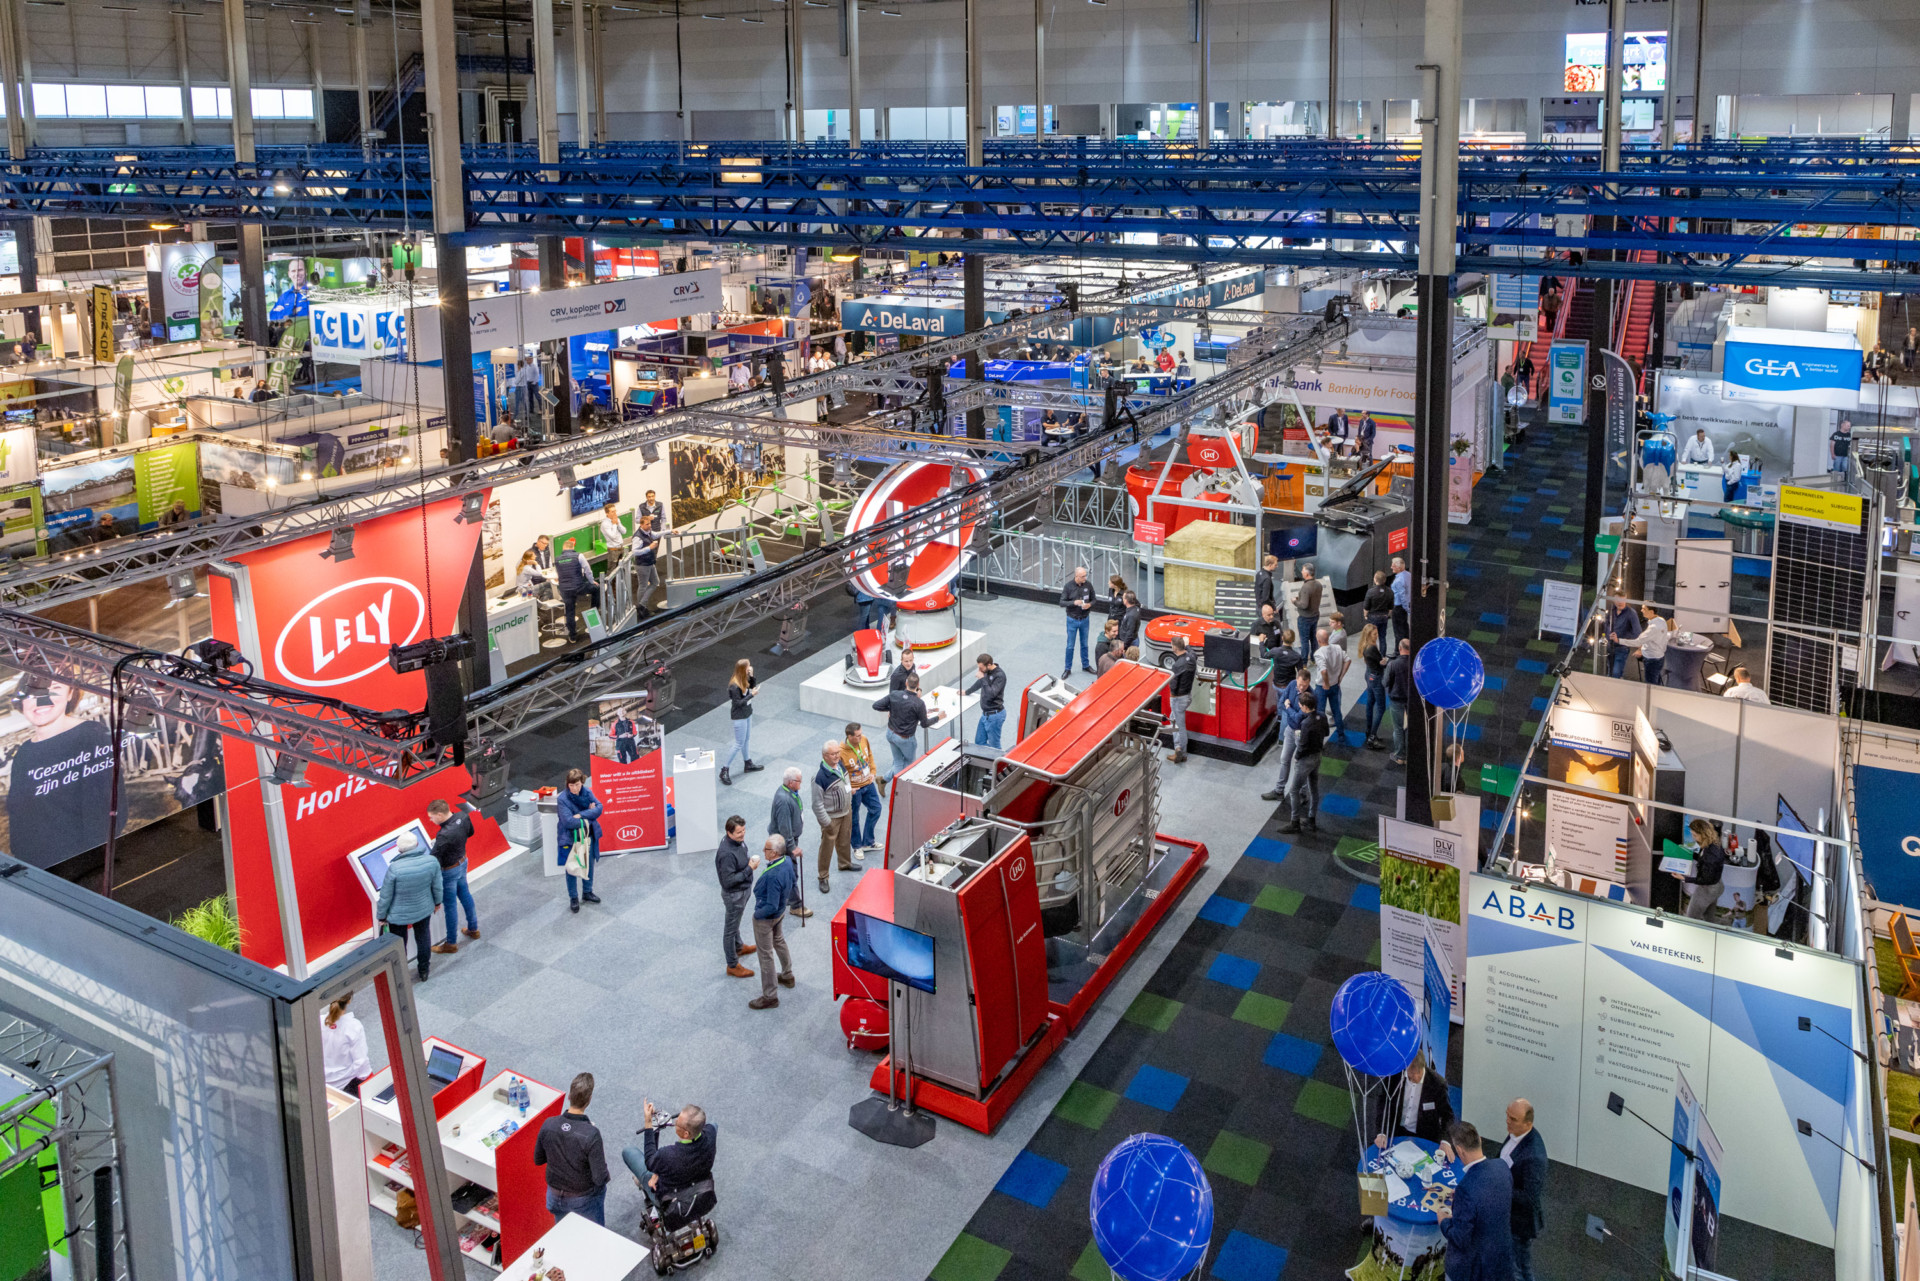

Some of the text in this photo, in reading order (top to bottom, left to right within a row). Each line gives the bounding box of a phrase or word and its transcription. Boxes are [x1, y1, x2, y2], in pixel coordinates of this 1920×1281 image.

[1580, 47, 1606, 57] Foo
[673, 284, 691, 296] CRV
[1231, 278, 1256, 300] DeLaval
[569, 303, 601, 316] koploper
[100, 292, 108, 359] TORNADO
[321, 310, 365, 343] GD
[880, 310, 944, 333] DeLaval
[1745, 358, 1800, 378] GEA
[1265, 375, 1323, 392] abbank
[1328, 382, 1370, 398] Banking
[1373, 386, 1388, 397] for
[1699, 384, 1721, 395] GE
[1700, 416, 1743, 425] melkkwaliteit
[1785, 489, 1824, 500] ZONNEPANELEN
[1783, 503, 1825, 514] ENERGIE-OPSLAG
[1830, 503, 1857, 512] SUBSIDIES
[309, 588, 393, 674] LELY
[1614, 723, 1631, 733] DLV
[1555, 732, 1603, 745] BEDRIJFSOVERNAME
[28, 735, 136, 781] "Gezonde koen
[35, 757, 115, 796] zijn de basis
[296, 760, 398, 821] Horizn
[1436, 840, 1452, 851] DLV
[1901, 835, 1920, 857] Q
[1482, 890, 1575, 930] ABAB
[1630, 939, 1704, 964] VAN BETEKENIS.
[1499, 970, 1541, 984] ACCOUNTANCY
[1499, 981, 1515, 989] AUDIT
[1525, 987, 1558, 1000] ASSURANCE
[1498, 992, 1548, 1009] BELASTINGADVIES
[1498, 1003, 1520, 1013] SALARIS
[1610, 999, 1661, 1016] INTERNATIONAAL
[1498, 1008, 1559, 1029] PERSONEELSDIENSTEN
[1610, 1004, 1653, 1019] ONDERNEMEN
[1497, 1019, 1545, 1036] PENSIOENADVIES
[1497, 1030, 1547, 1048] JURIDISCH ADVIES
[1609, 1029, 1661, 1047] ESTATE PLANNING
[1496, 1041, 1555, 1061] CORPORATE FINANCE
[1608, 1041, 1691, 1069] RUIMTELIJKE VERORDENING
[1618, 1050, 1638, 1059] MILIEU
[1608, 1060, 1674, 1082] VASTGOEDADVISERING
[1607, 1072, 1669, 1094] STRATEGISCH ADVIES
[1392, 1196, 1430, 1213] BAB
